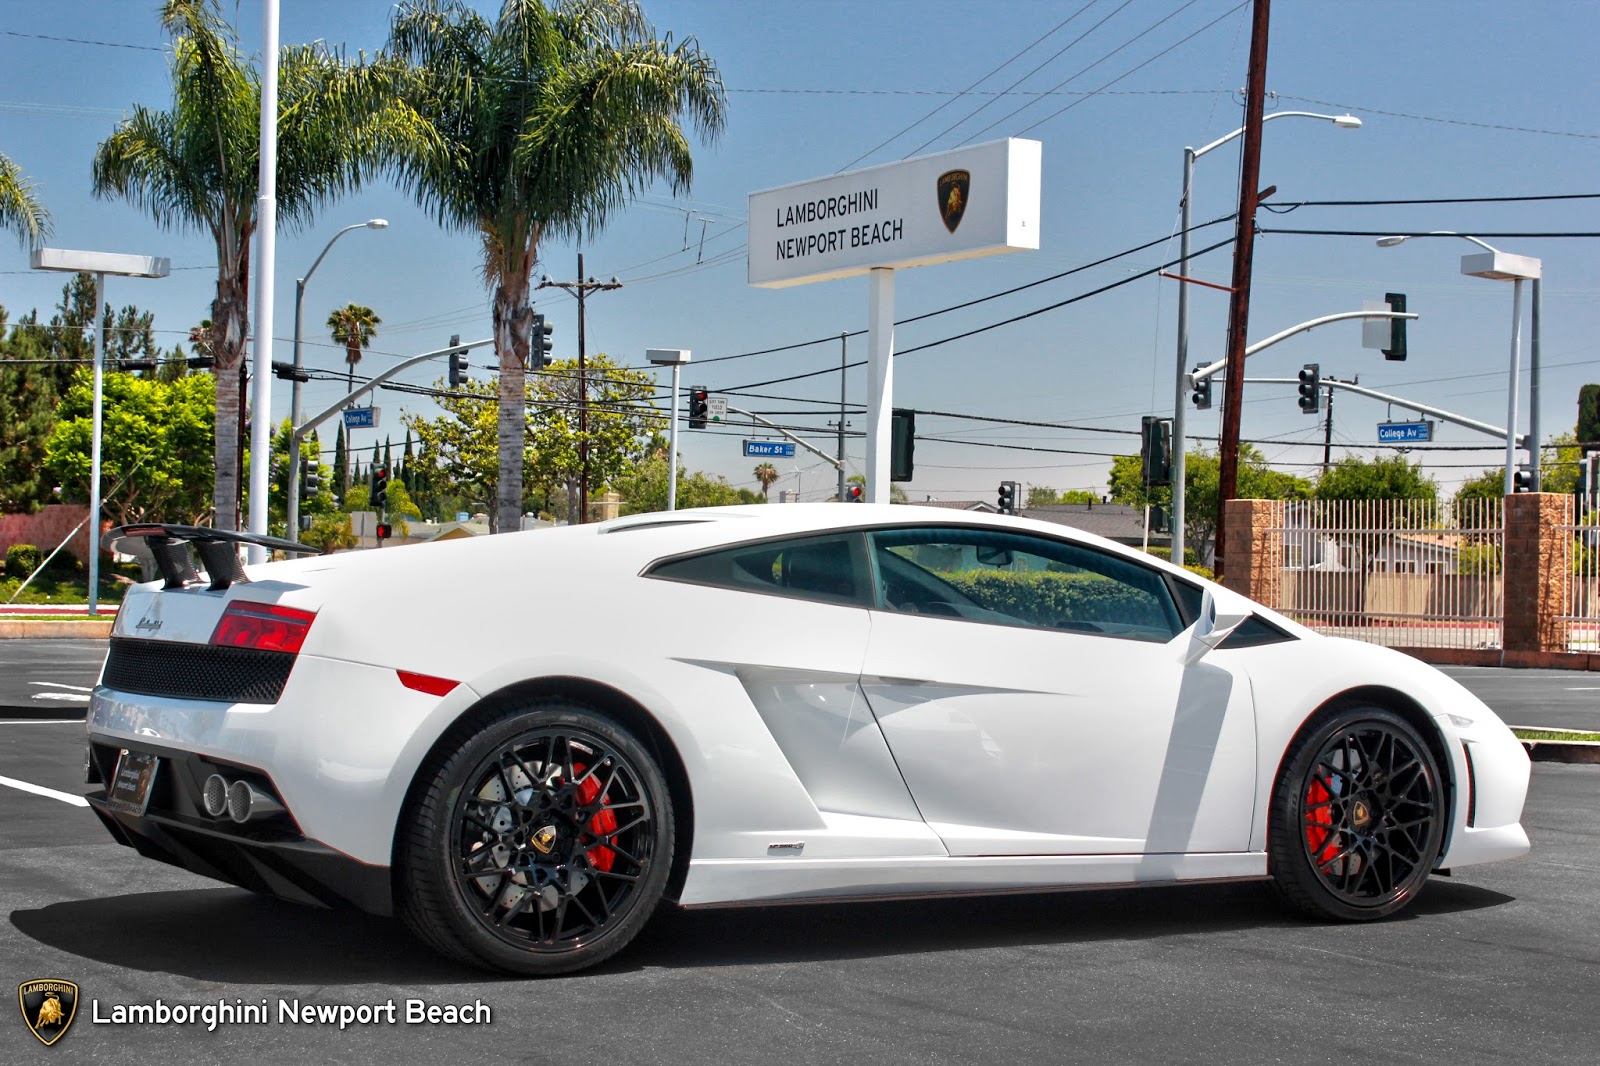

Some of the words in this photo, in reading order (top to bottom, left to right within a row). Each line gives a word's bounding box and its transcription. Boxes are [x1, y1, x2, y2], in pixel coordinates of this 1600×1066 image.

[776, 188, 878, 228] LAMBORGHINI
[776, 229, 847, 260] NEWPORT
[851, 218, 903, 248] BEACH
[1380, 428, 1405, 440] College
[1407, 427, 1417, 437] Av
[749, 444, 772, 454] Baker
[774, 445, 783, 454] St
